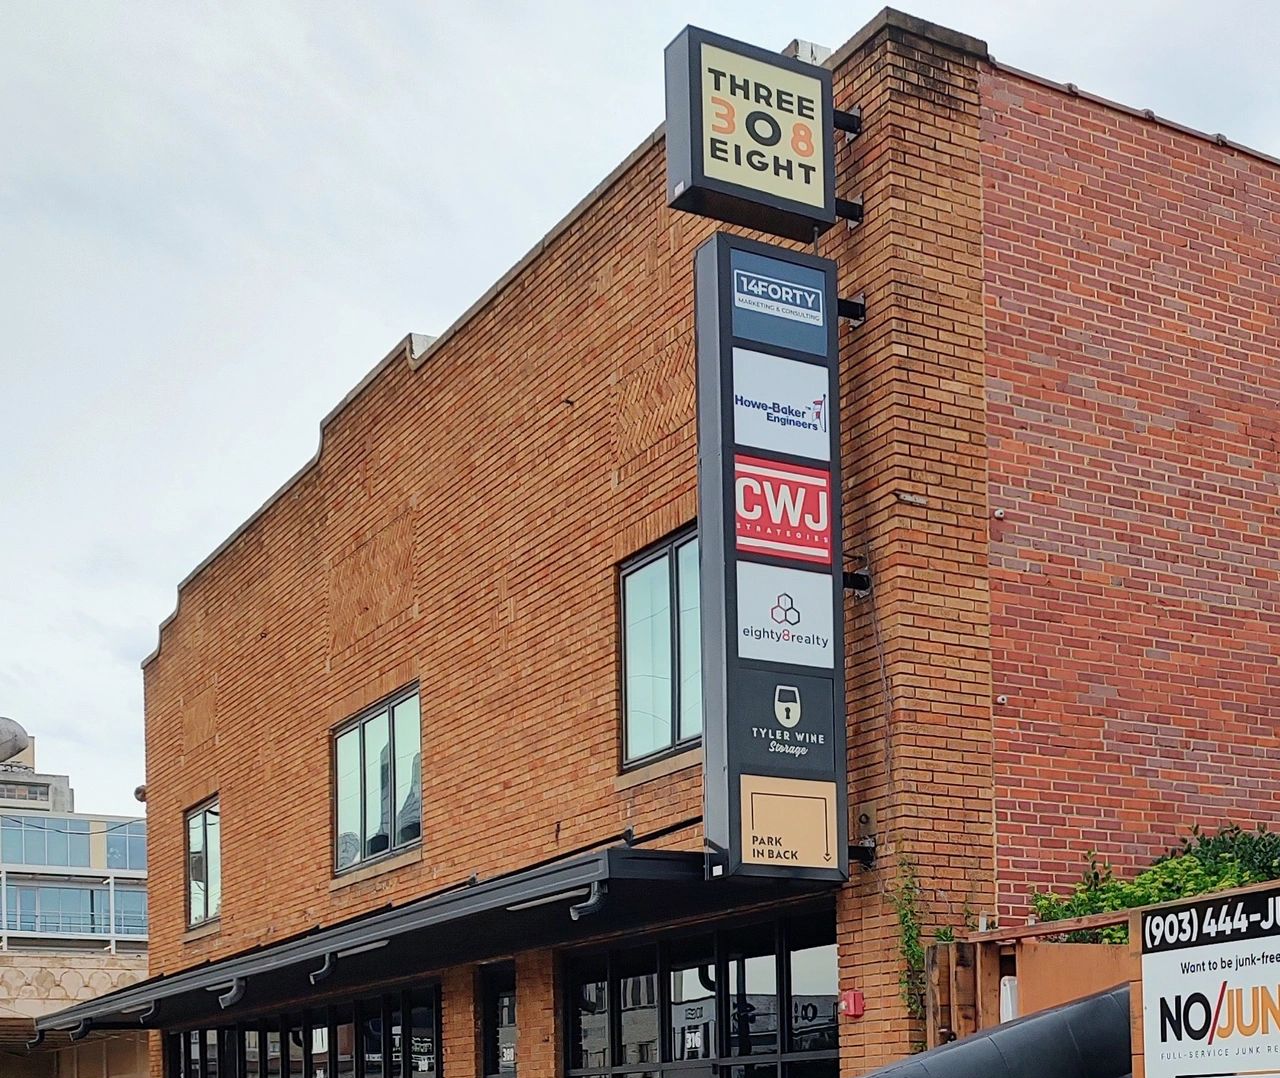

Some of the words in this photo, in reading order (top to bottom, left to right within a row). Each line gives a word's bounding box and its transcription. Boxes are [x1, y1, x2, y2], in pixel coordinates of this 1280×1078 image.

[708, 67, 814, 120] THREE
[710, 137, 816, 185] EIGHT
[740, 276, 816, 308] 14FORTY
[738, 297, 775, 311] MARKETING
[781, 307, 820, 321] CONSULTING
[735, 394, 806, 419] Howe-Baker
[766, 412, 818, 432] Engineers
[735, 477, 828, 532] CWJ
[736, 522, 828, 544] STRATEGIES
[742, 626, 829, 648] eighty8realty
[752, 727, 790, 741] TYLER
[795, 731, 825, 745] WINE
[768, 740, 809, 758] Storage
[752, 835, 783, 847] PARK
[752, 848, 765, 859] IN
[767, 850, 799, 860] BACK
[1144, 908, 1198, 949] (903)
[1180, 960, 1206, 974] Want
[1208, 959, 1218, 971] to
[1220, 957, 1233, 970] be
[1160, 1048, 1229, 1061] FULL-SERVICE
[1235, 1046, 1261, 1056] JUNK
